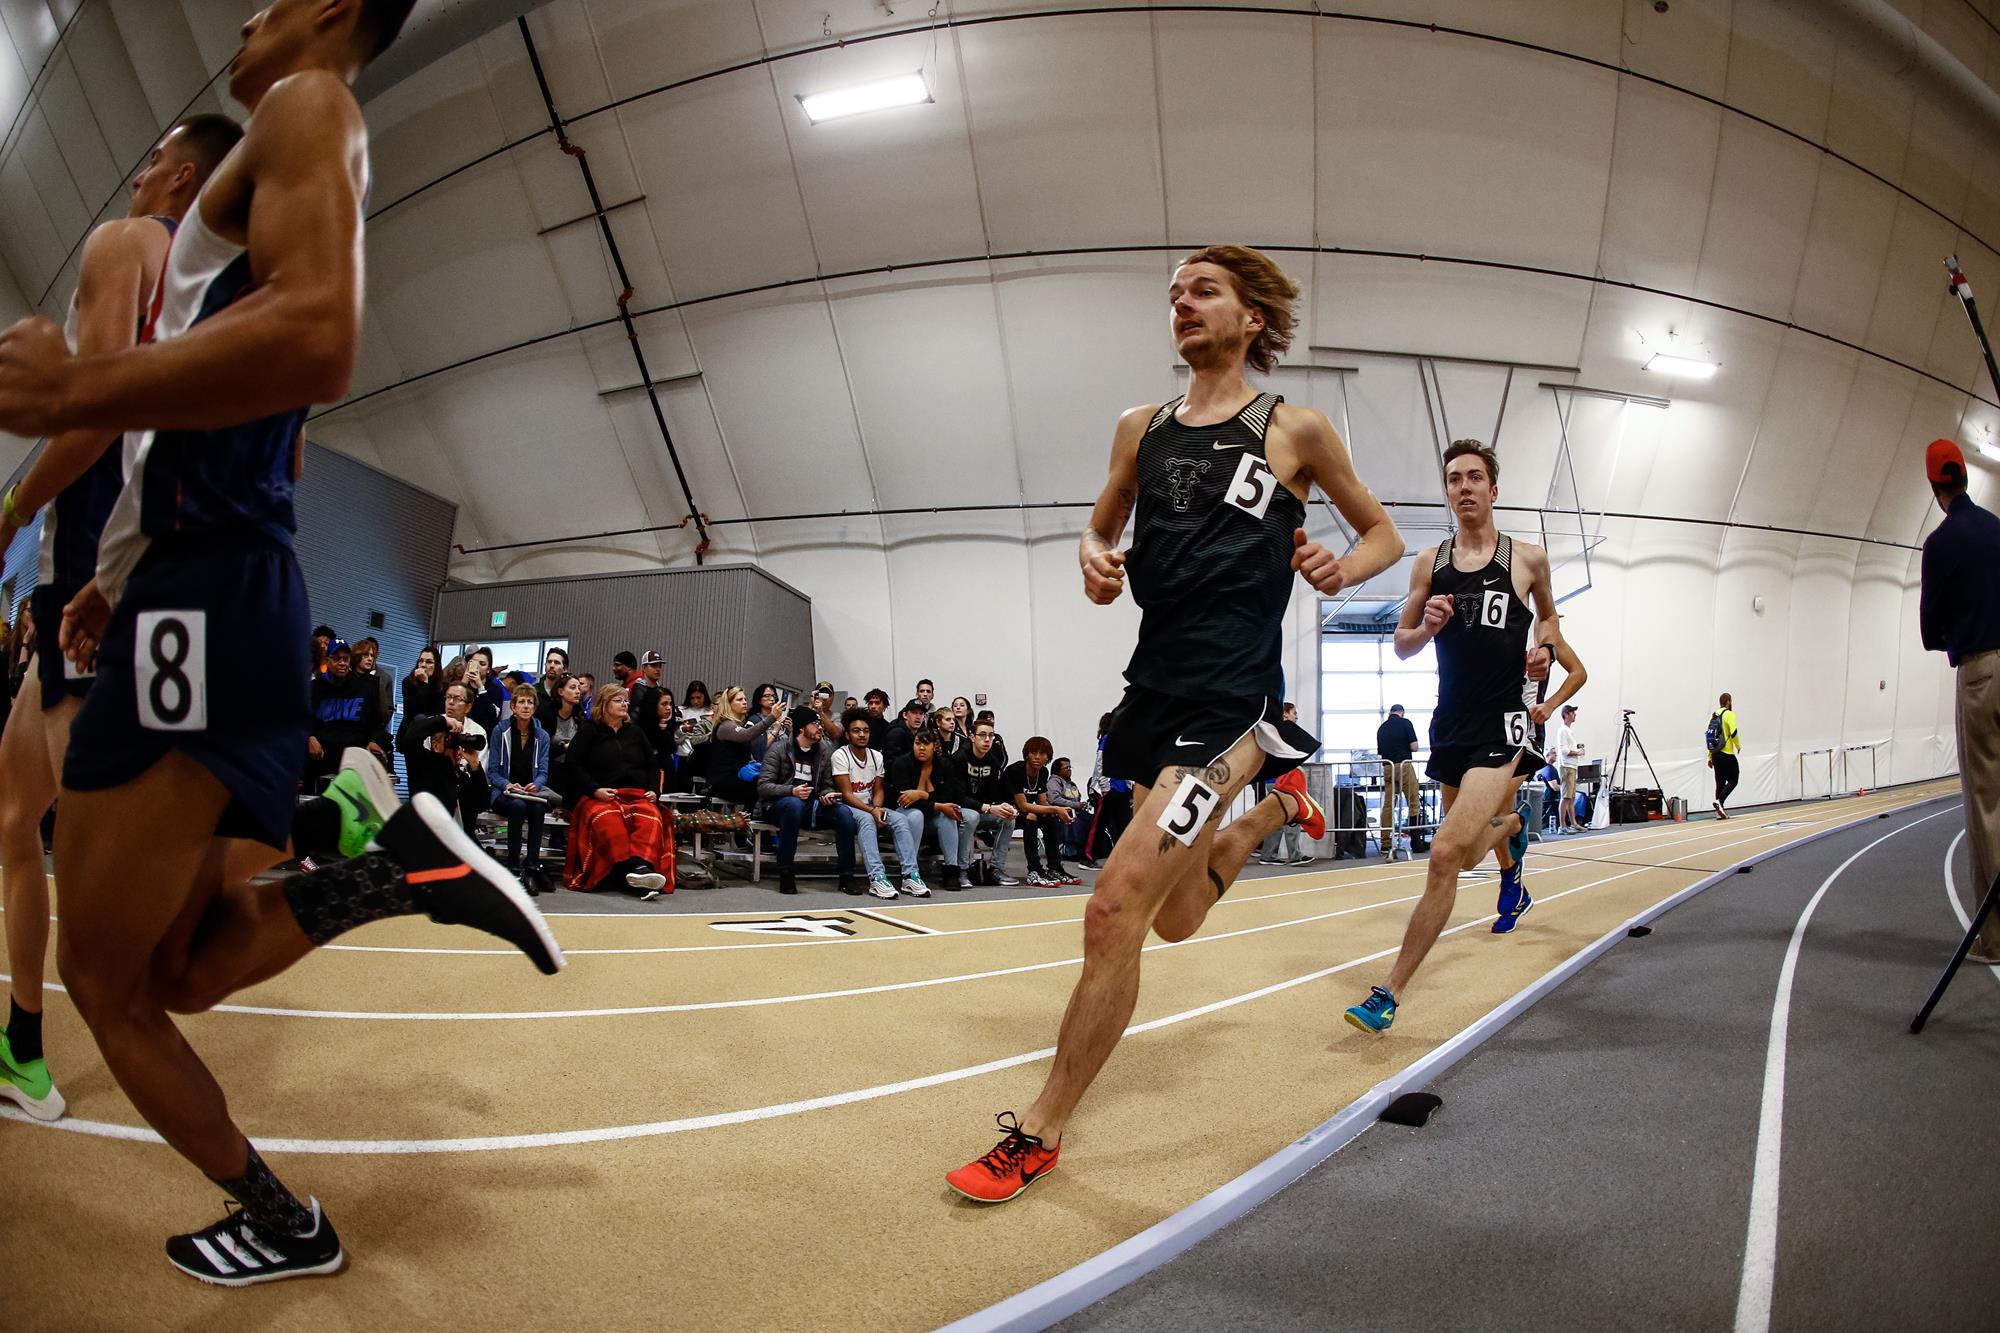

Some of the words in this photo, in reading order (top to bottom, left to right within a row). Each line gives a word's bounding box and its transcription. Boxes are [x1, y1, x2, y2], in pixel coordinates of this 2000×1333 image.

[1234, 459, 1271, 509] 5
[1487, 593, 1503, 625] 6
[149, 617, 192, 725] 8
[1510, 713, 1524, 745] 6
[1168, 783, 1212, 835] 5
